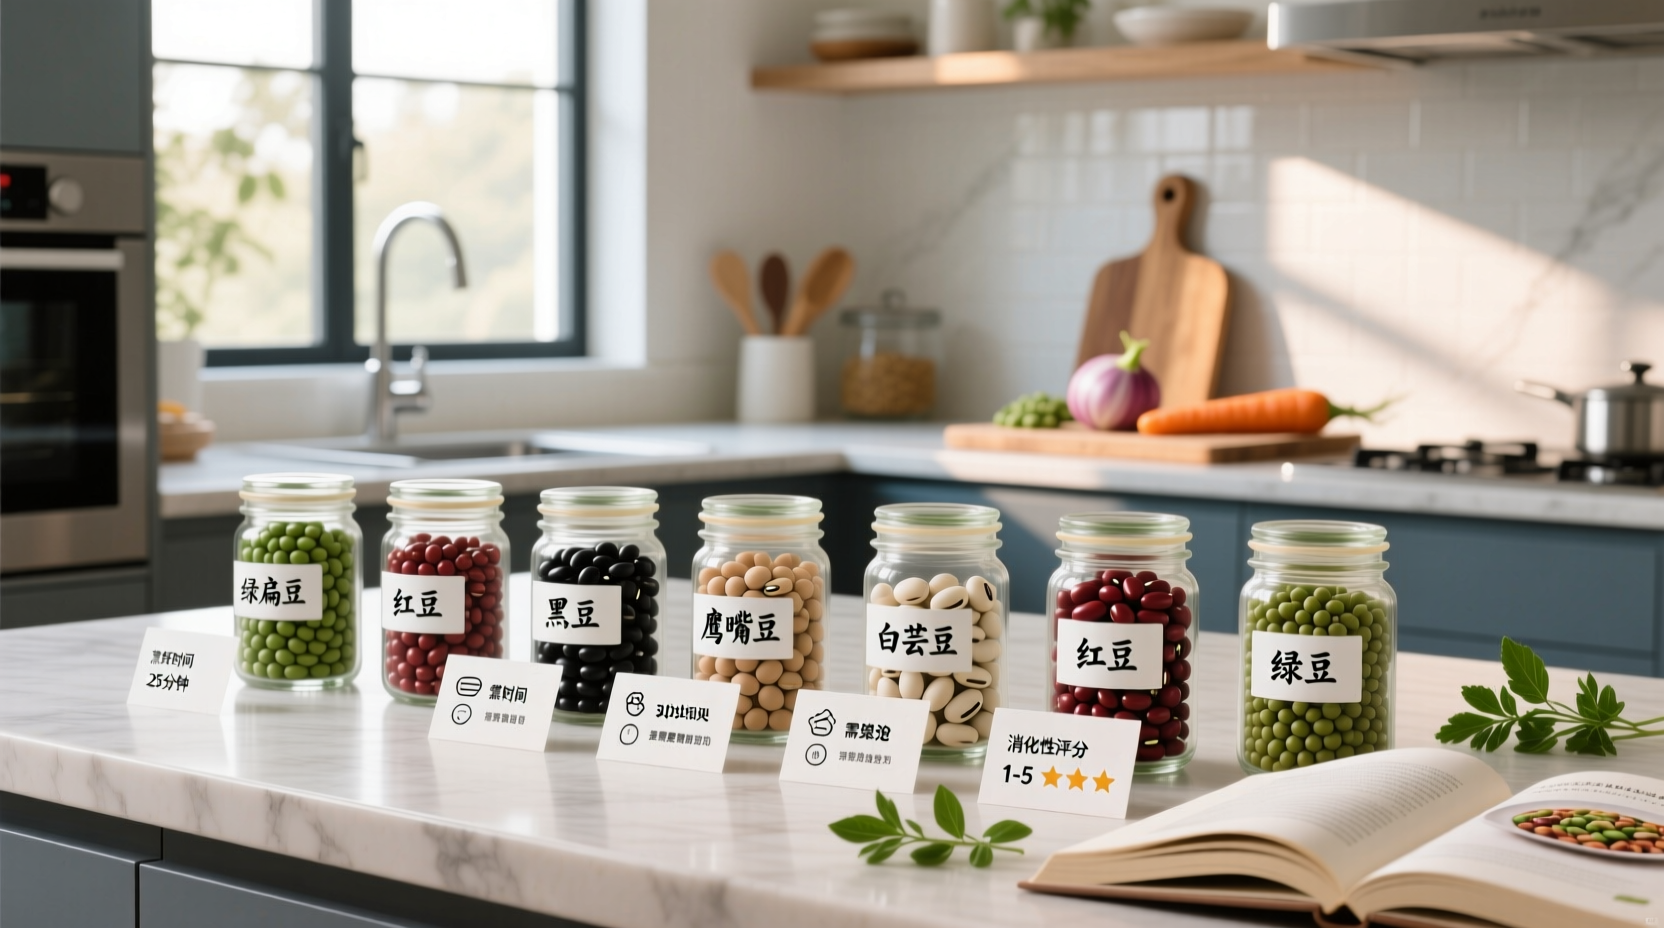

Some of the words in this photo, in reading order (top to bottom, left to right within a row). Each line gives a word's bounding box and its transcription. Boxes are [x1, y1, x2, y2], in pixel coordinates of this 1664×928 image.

[240, 577, 306, 607] 绿扁豆
[393, 588, 443, 618] 红豆
[546, 597, 600, 630] 黑豆
[701, 607, 780, 646] 鹰嘴豆
[878, 622, 958, 656] 白芸豆
[1076, 637, 1137, 671] 红豆
[146, 673, 190, 693] 25分钟
[1271, 650, 1337, 685] 绿豆
[1007, 733, 1089, 759] 消化性评分
[1002, 764, 1034, 785] 1-5
